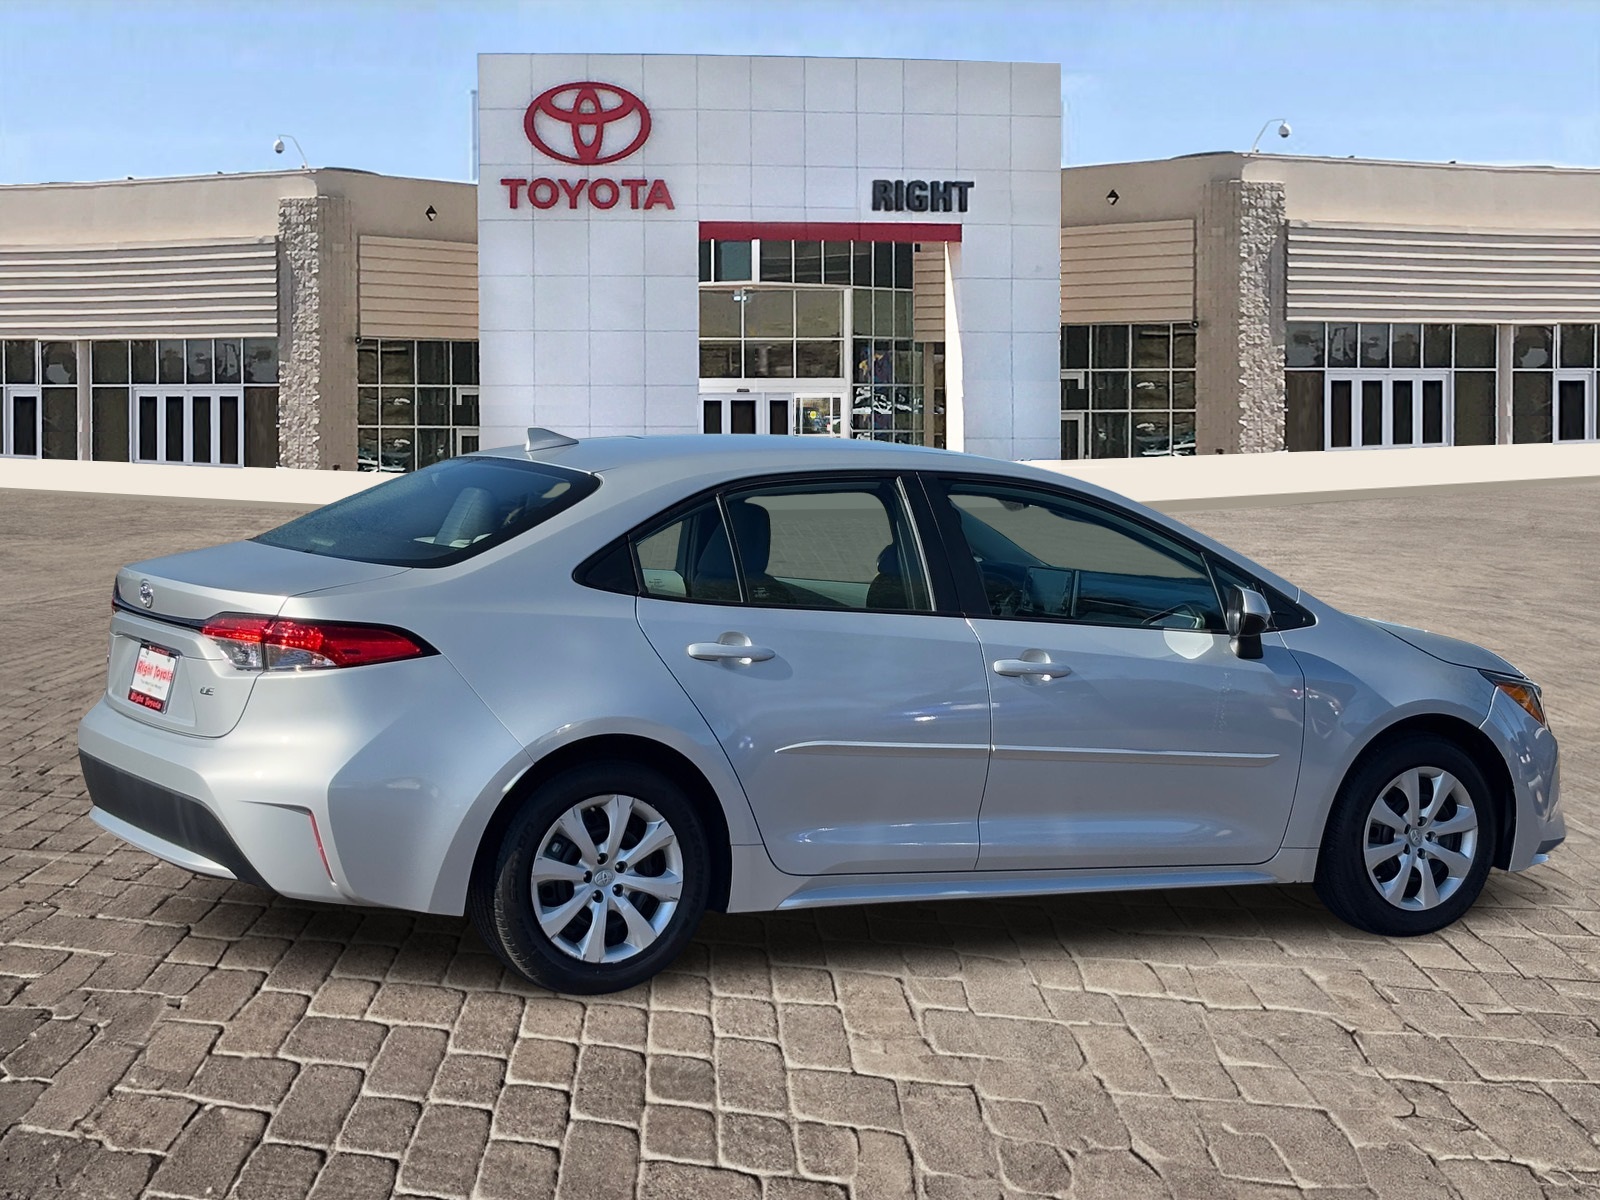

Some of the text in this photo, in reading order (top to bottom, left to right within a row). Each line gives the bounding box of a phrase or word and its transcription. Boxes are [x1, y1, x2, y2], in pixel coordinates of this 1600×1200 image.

[500, 178, 675, 210] TOYOTA
[872, 180, 975, 213] RIGHT
[137, 661, 173, 681] Right Toyota
[131, 693, 162, 709] Right Toyota
[200, 687, 215, 696] LE
